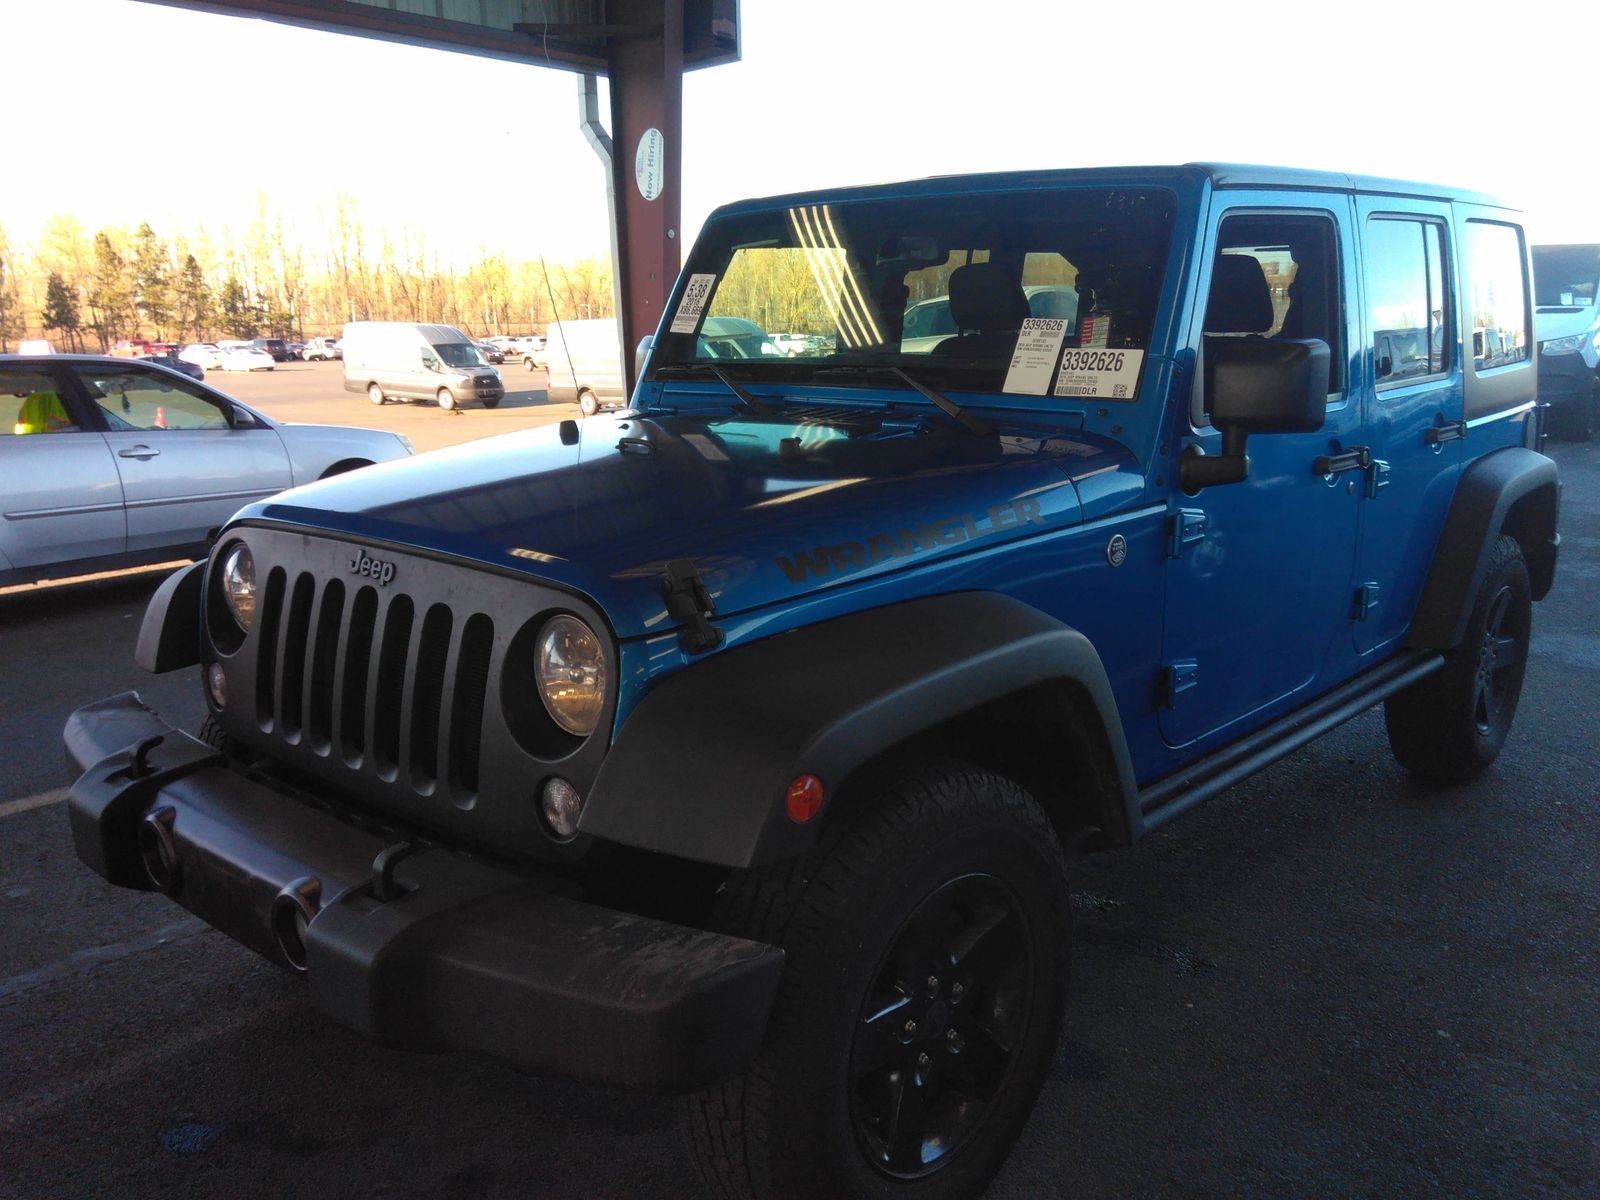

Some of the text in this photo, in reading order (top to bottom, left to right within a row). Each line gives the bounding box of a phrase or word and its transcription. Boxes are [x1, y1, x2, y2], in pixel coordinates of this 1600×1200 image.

[646, 130, 657, 199] Now Hiring
[1023, 319, 1064, 331] 3392626
[1062, 351, 1125, 372] 3392626
[1081, 387, 1098, 395] DLR
[774, 498, 1048, 584] WRANGLER
[349, 548, 396, 587] Jeep
